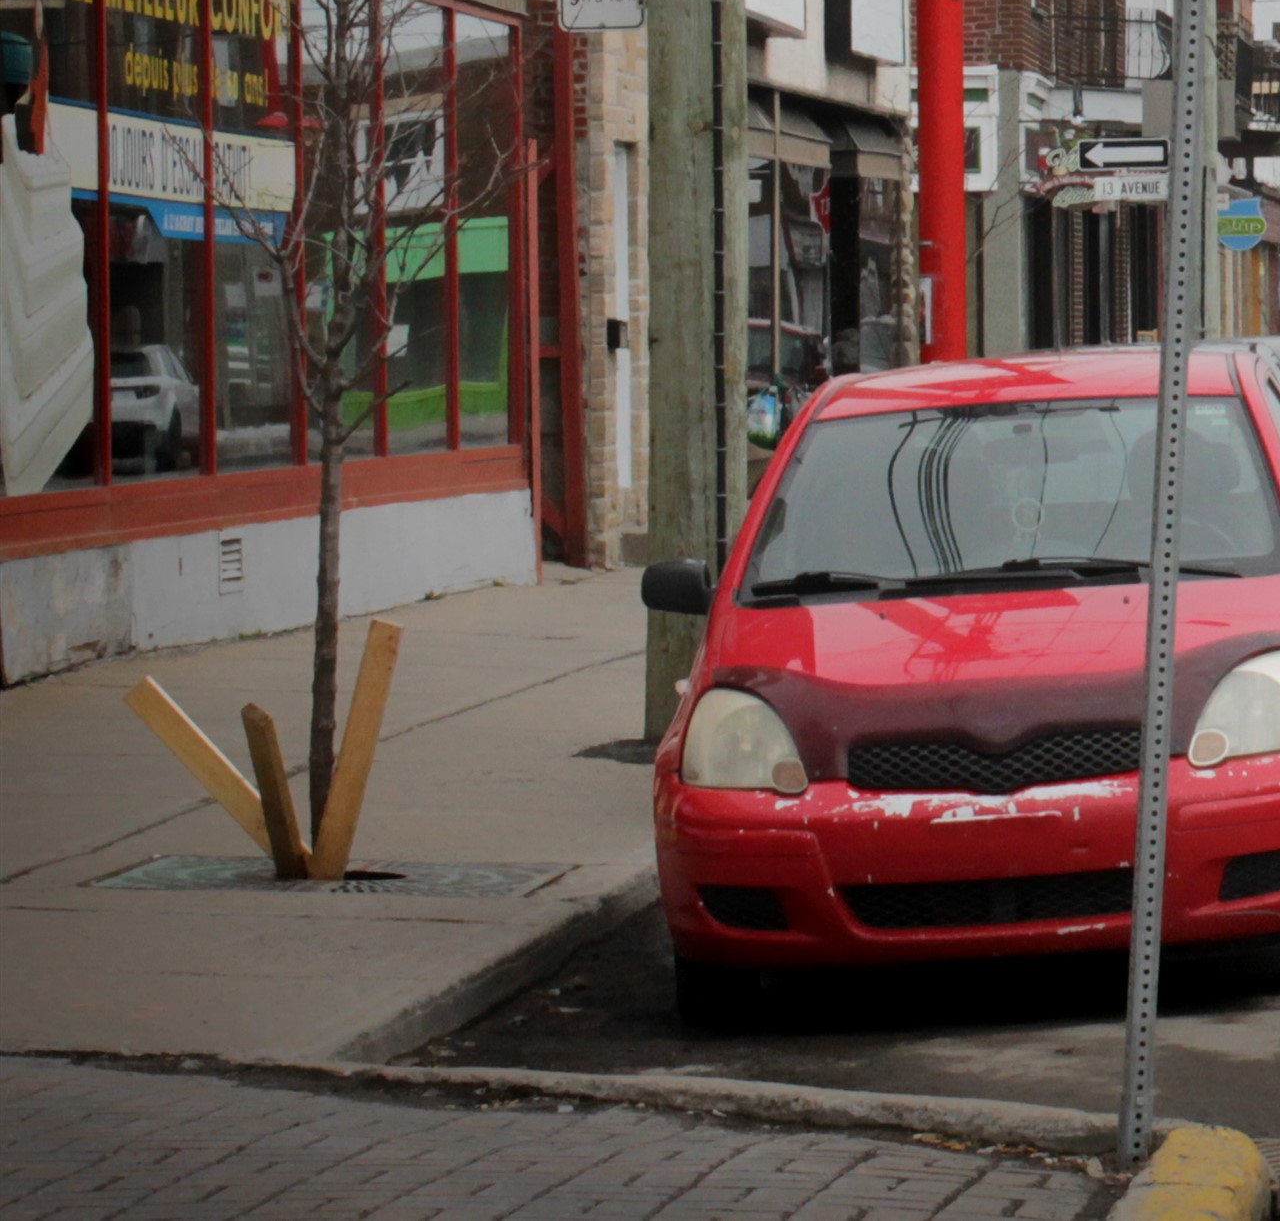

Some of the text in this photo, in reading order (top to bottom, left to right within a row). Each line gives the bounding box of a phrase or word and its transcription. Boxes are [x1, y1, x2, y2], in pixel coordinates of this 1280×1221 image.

[124, 43, 169, 97] depuis
[173, 51, 198, 101] plus
[1103, 182, 1114, 196] 13
[1121, 181, 1160, 195] AVENUE
